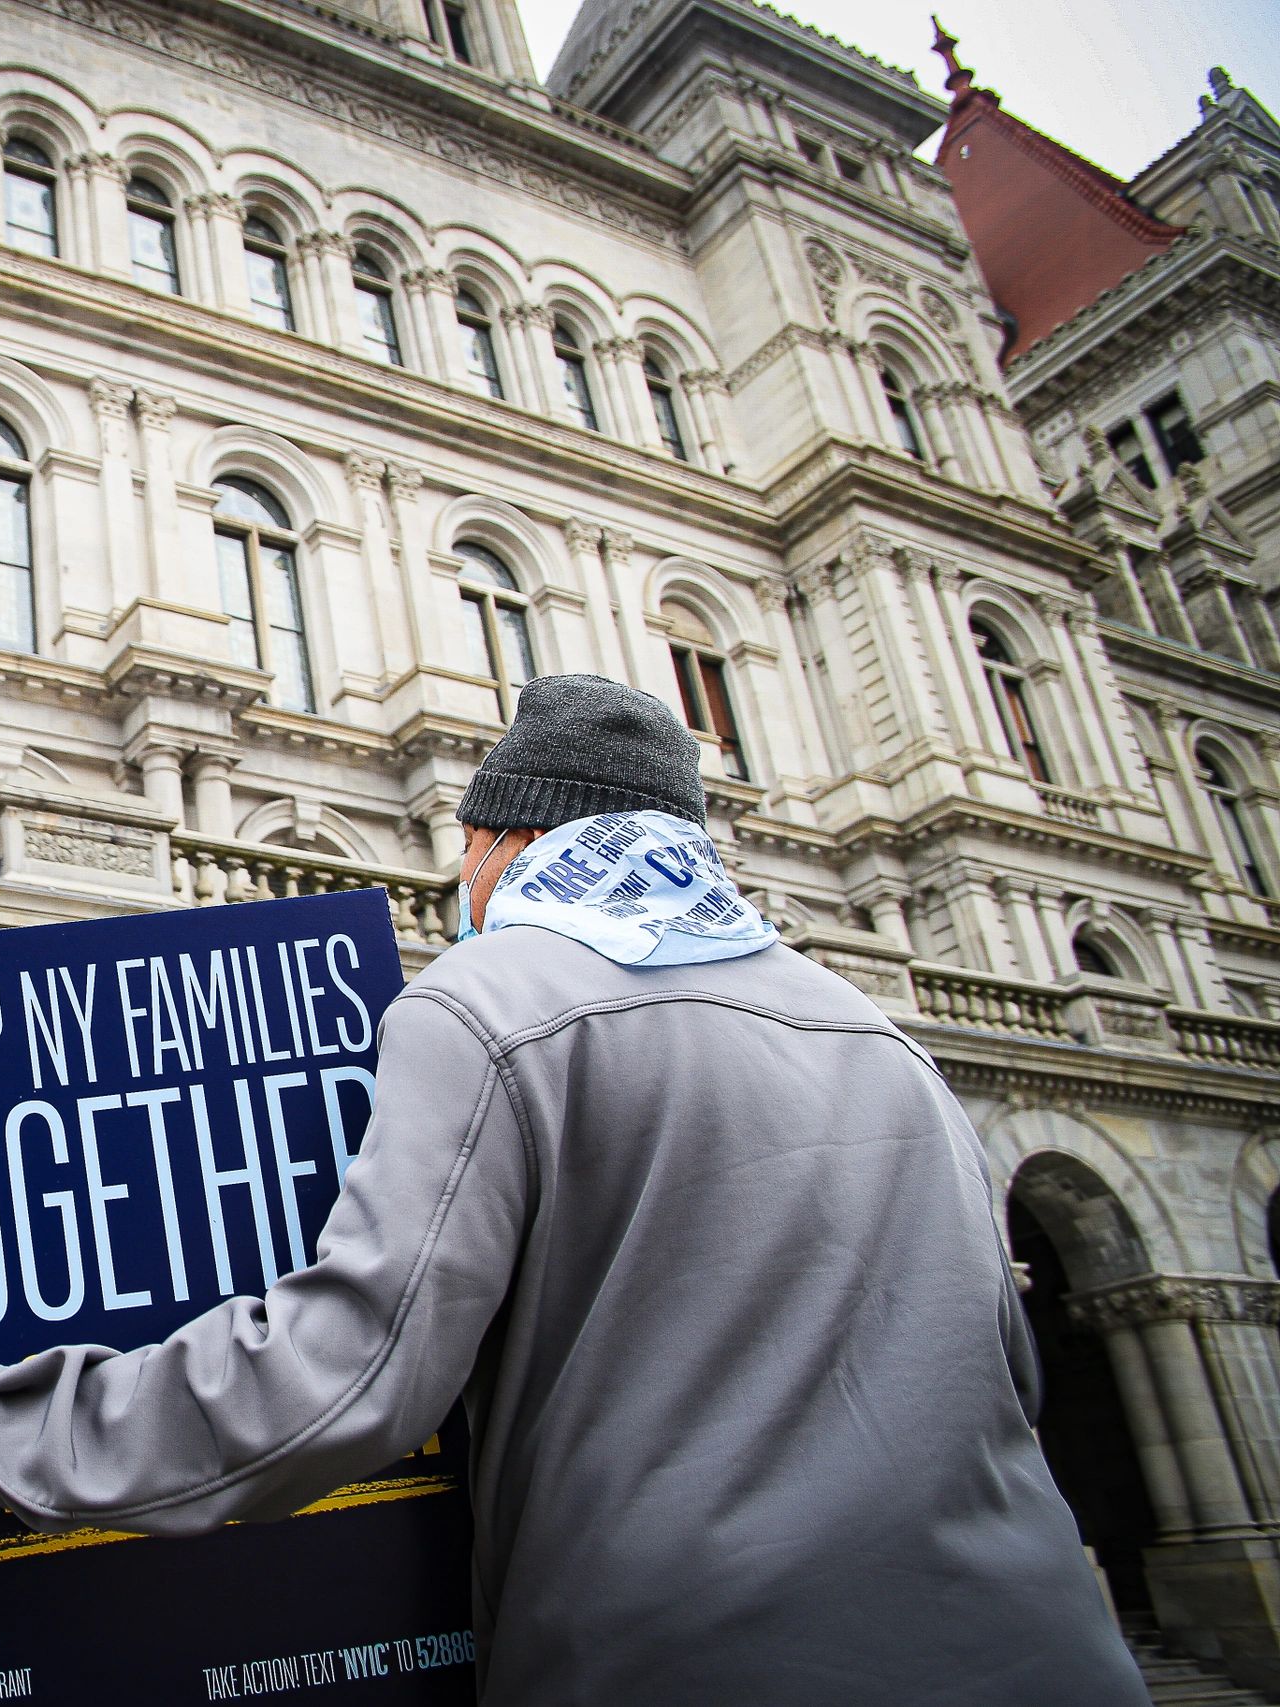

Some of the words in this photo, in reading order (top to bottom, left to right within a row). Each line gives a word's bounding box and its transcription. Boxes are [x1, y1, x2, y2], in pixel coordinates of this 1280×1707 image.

[575, 826, 608, 851] FOR
[596, 820, 646, 865] FAMILIES
[521, 848, 608, 904] CARE
[20, 964, 98, 1088] NY
[116, 934, 372, 1077] FAMILIES
[203, 1665, 240, 1700] TAKE
[242, 1656, 300, 1695] ACTION!
[300, 1651, 336, 1686] TEXT
[393, 1639, 414, 1672] TO
[415, 1630, 476, 1669] 52886
